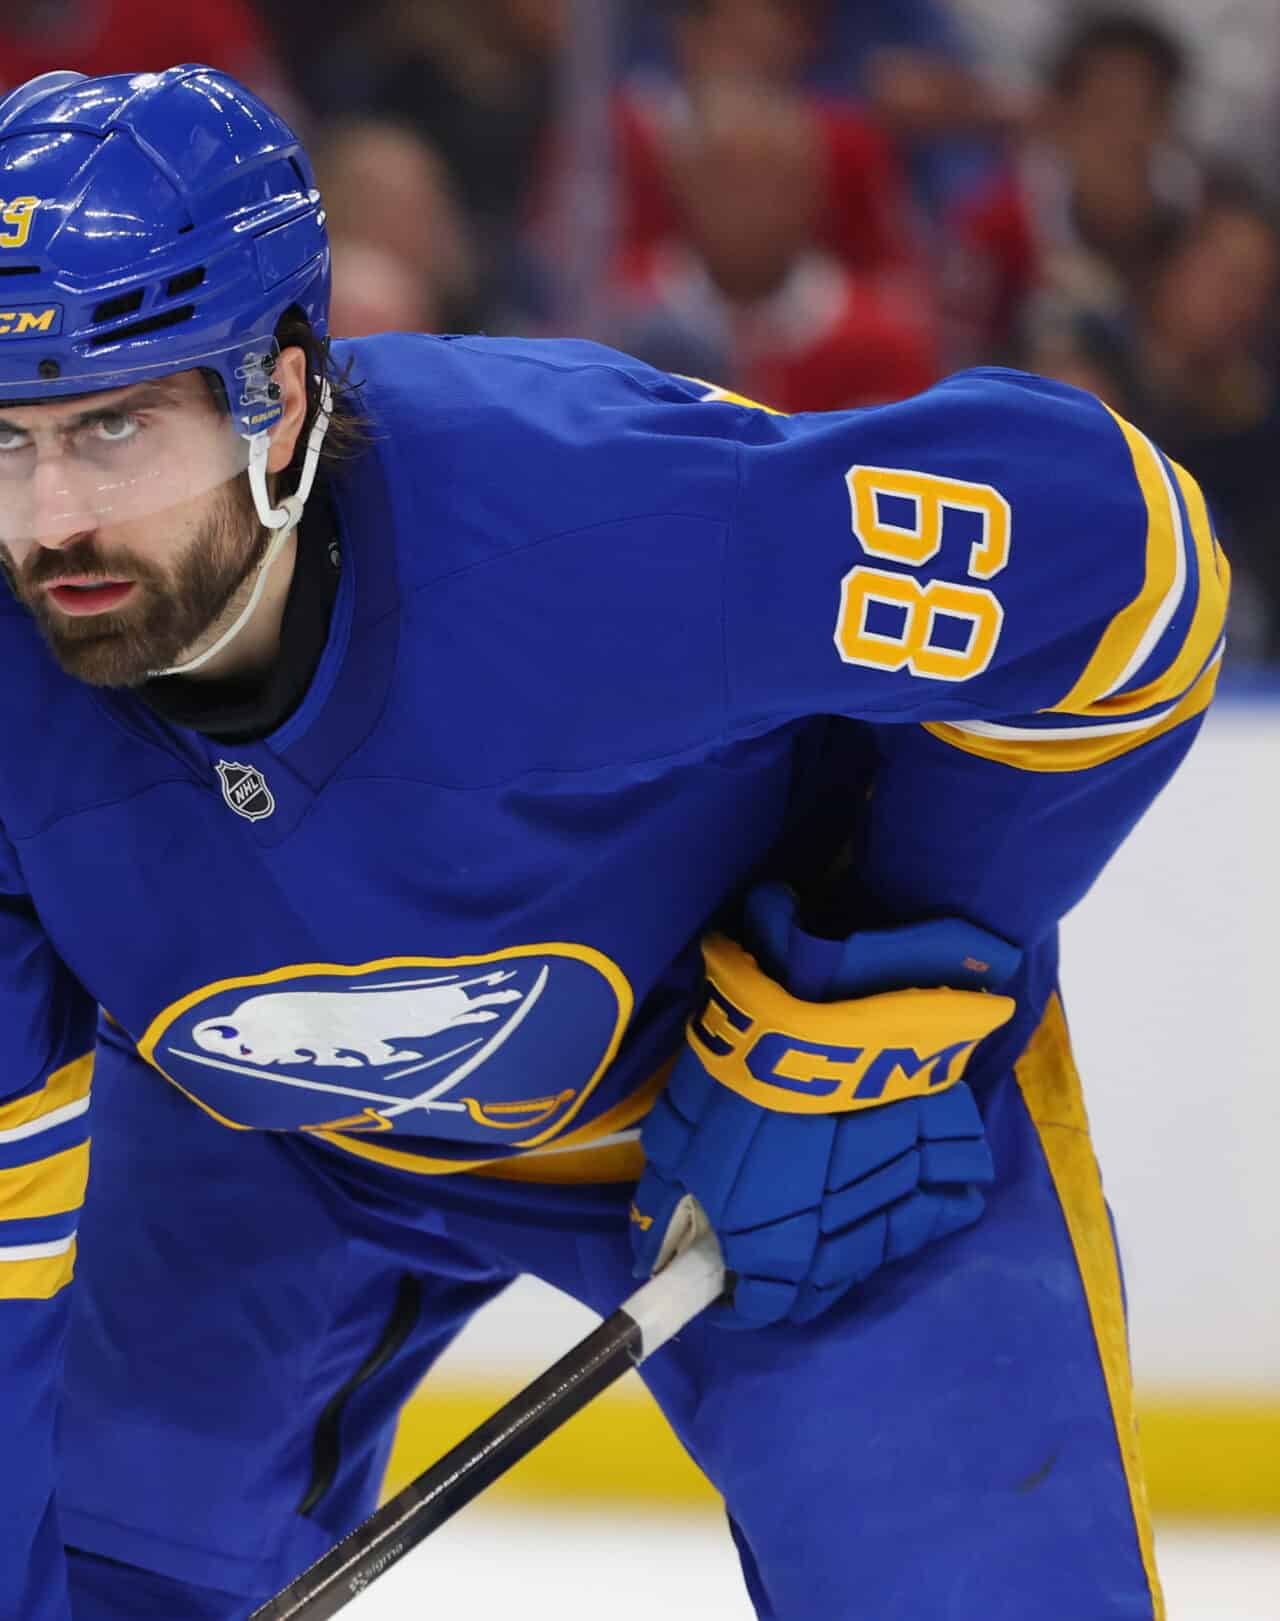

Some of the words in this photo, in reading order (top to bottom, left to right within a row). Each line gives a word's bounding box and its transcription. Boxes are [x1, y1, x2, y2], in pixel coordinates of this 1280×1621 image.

[833, 464, 1012, 682] 89
[235, 777, 259, 804] NHL
[692, 977, 980, 1100] CCM
